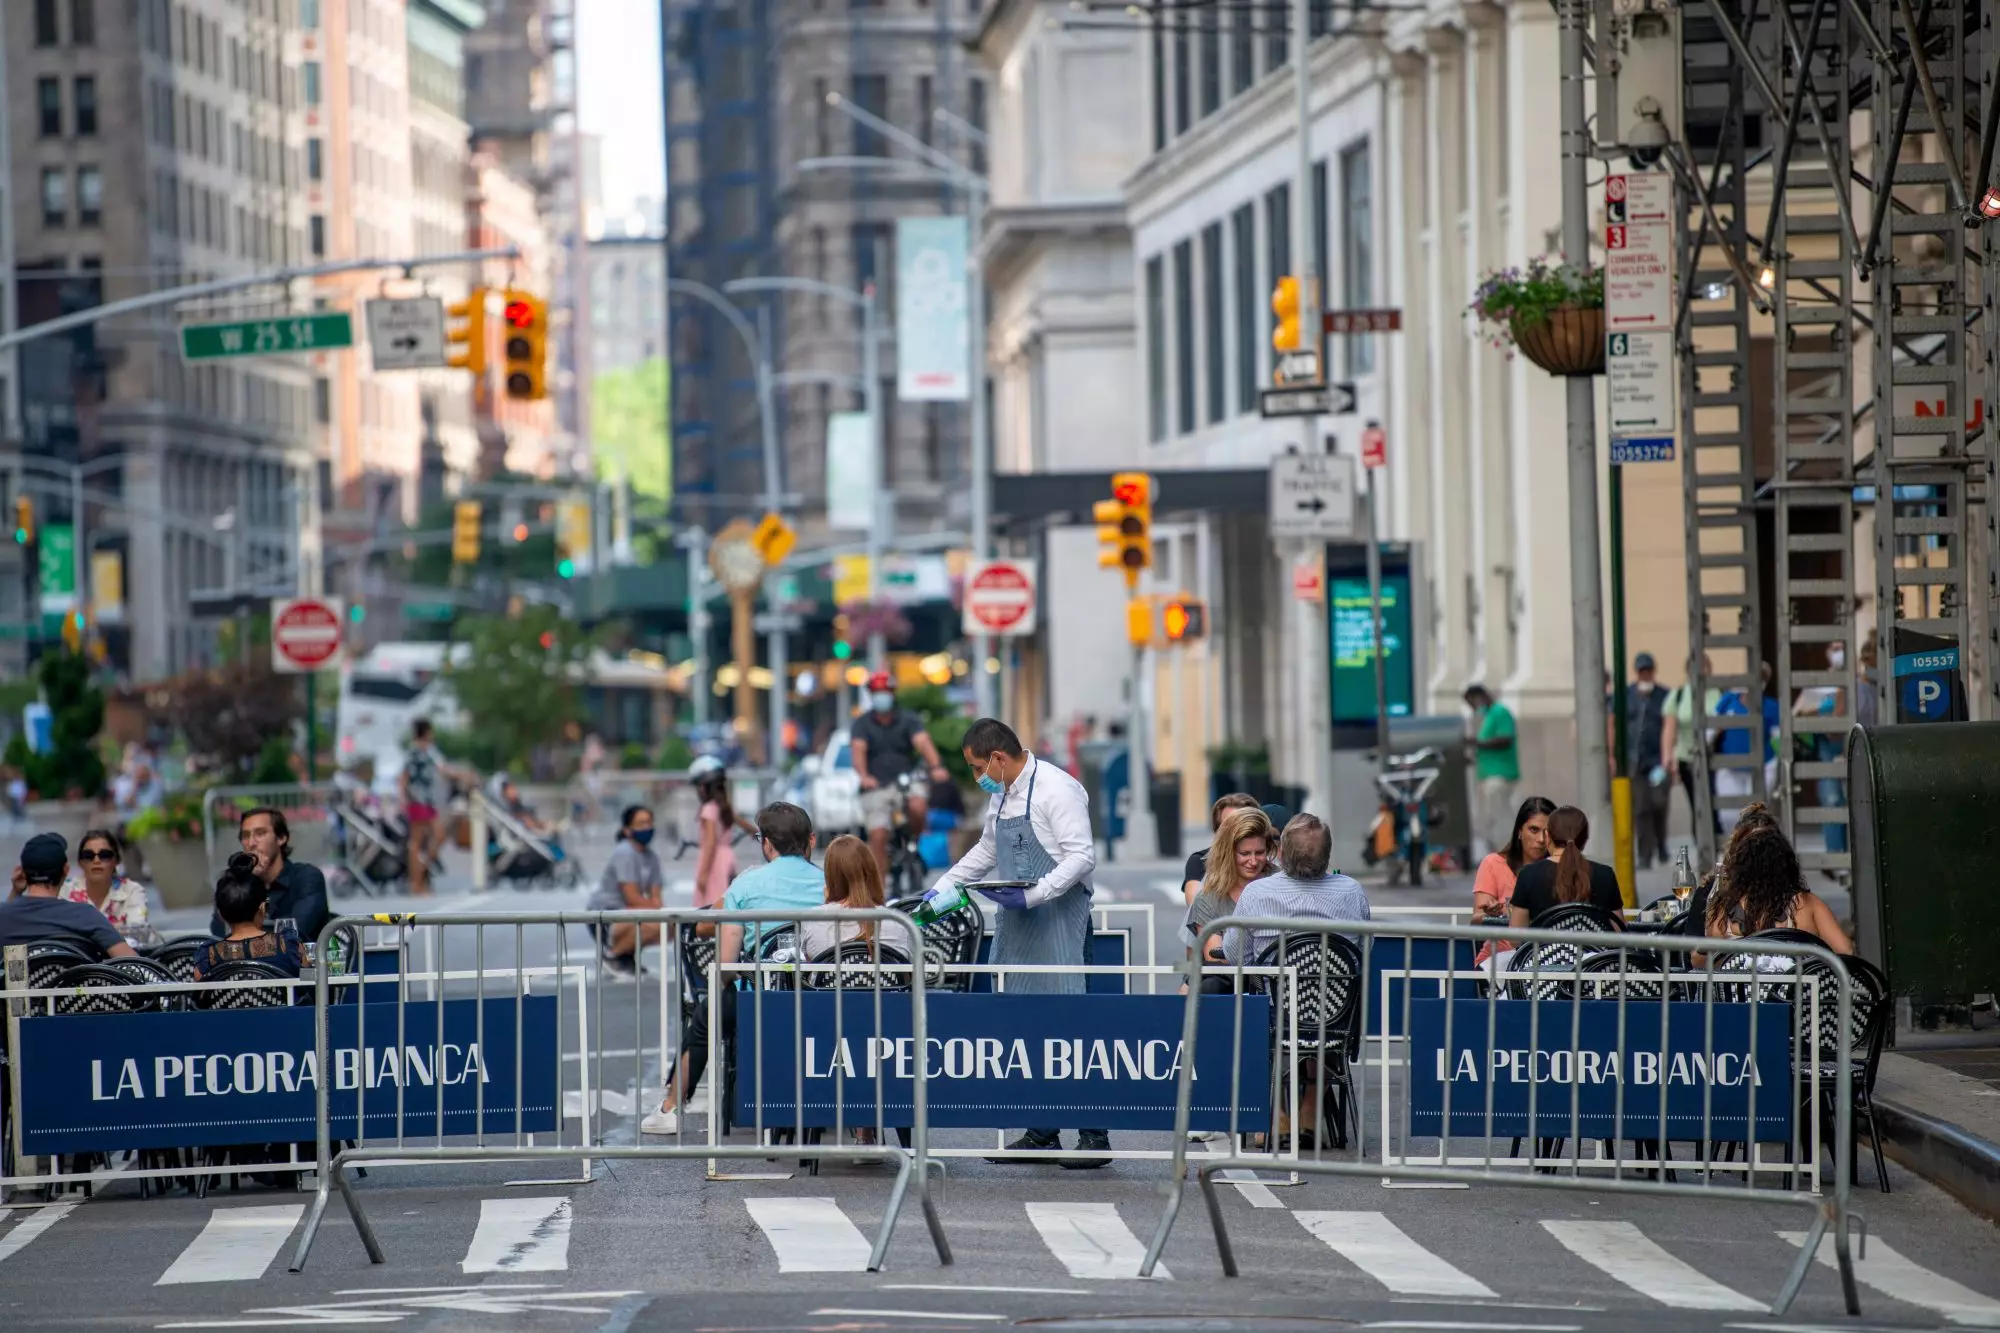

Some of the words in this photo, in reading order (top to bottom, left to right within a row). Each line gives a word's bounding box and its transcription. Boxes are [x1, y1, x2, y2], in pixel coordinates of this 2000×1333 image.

[1647, 264, 1667, 275] ONLY
[219, 327, 243, 352] W
[253, 322, 281, 350] 25
[1613, 335, 1625, 355] 6
[1912, 655, 1954, 668] 105537
[1918, 680, 1940, 713] P
[91, 1058, 144, 1100] LA
[155, 1051, 320, 1098] PECORA
[335, 1043, 490, 1091] BIANCA
[805, 1037, 856, 1078] LA
[866, 1037, 1033, 1080] PECORA
[1044, 1038, 1198, 1082] BIANCA
[1436, 1048, 1479, 1082] LA
[1488, 1049, 1625, 1084] PECORA
[1633, 1051, 1762, 1087] BIANCA
